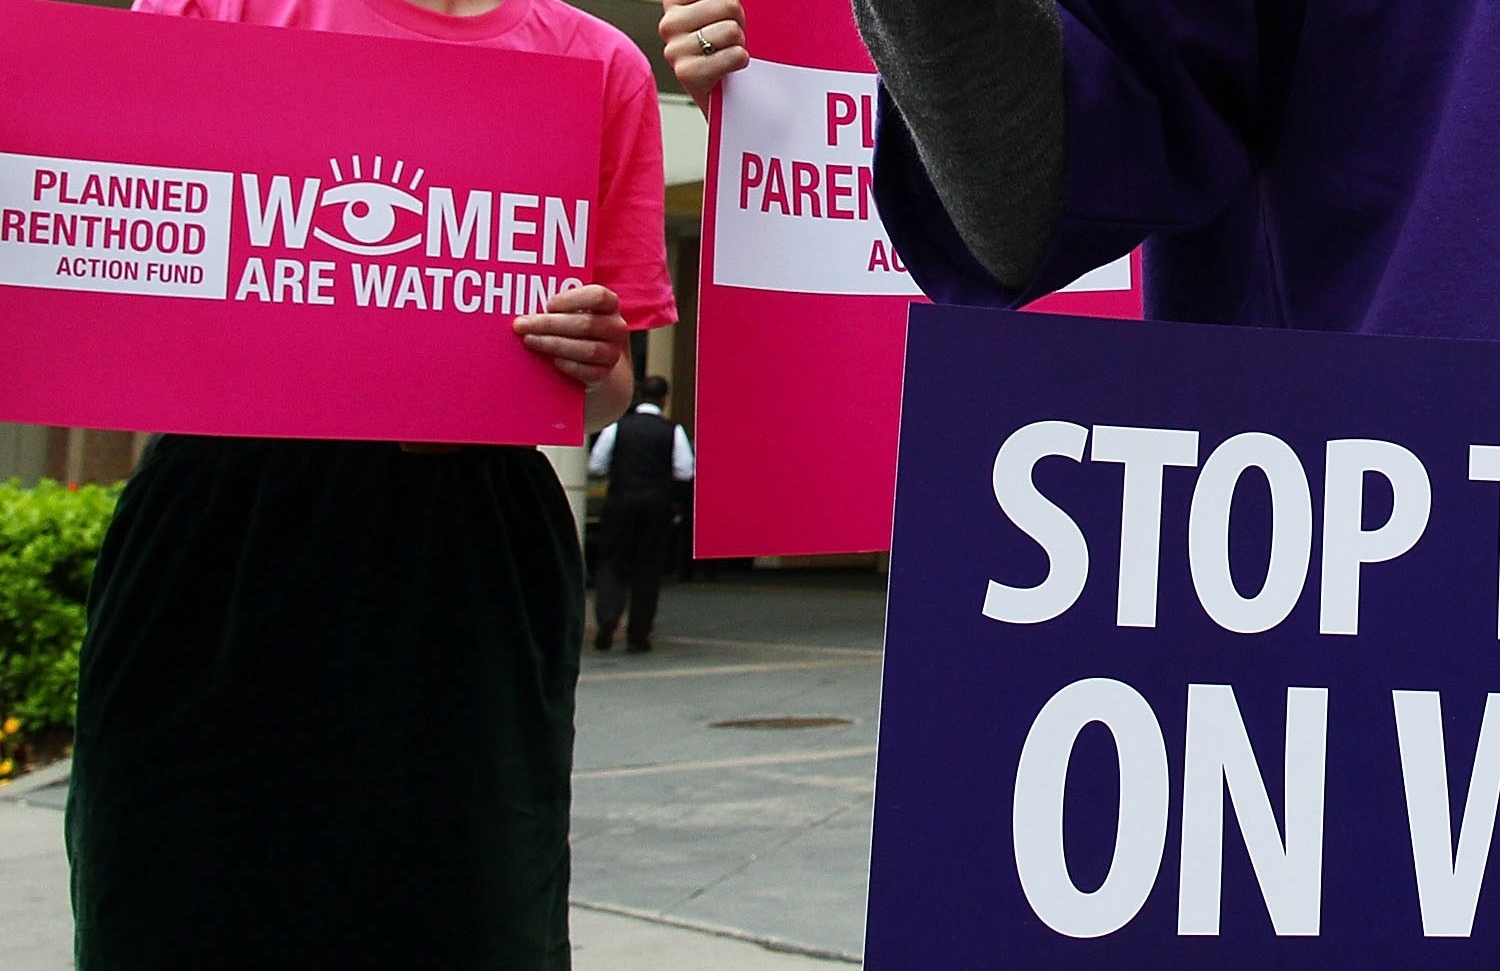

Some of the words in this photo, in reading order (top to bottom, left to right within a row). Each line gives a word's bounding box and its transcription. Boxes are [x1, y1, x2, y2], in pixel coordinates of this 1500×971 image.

[33, 169, 209, 213] PLANNED
[56, 257, 139, 280] ACTION
[146, 263, 204, 284] FUND
[235, 257, 335, 305] ARE
[982, 420, 1431, 635] STOP
[1012, 677, 1330, 939] ON
